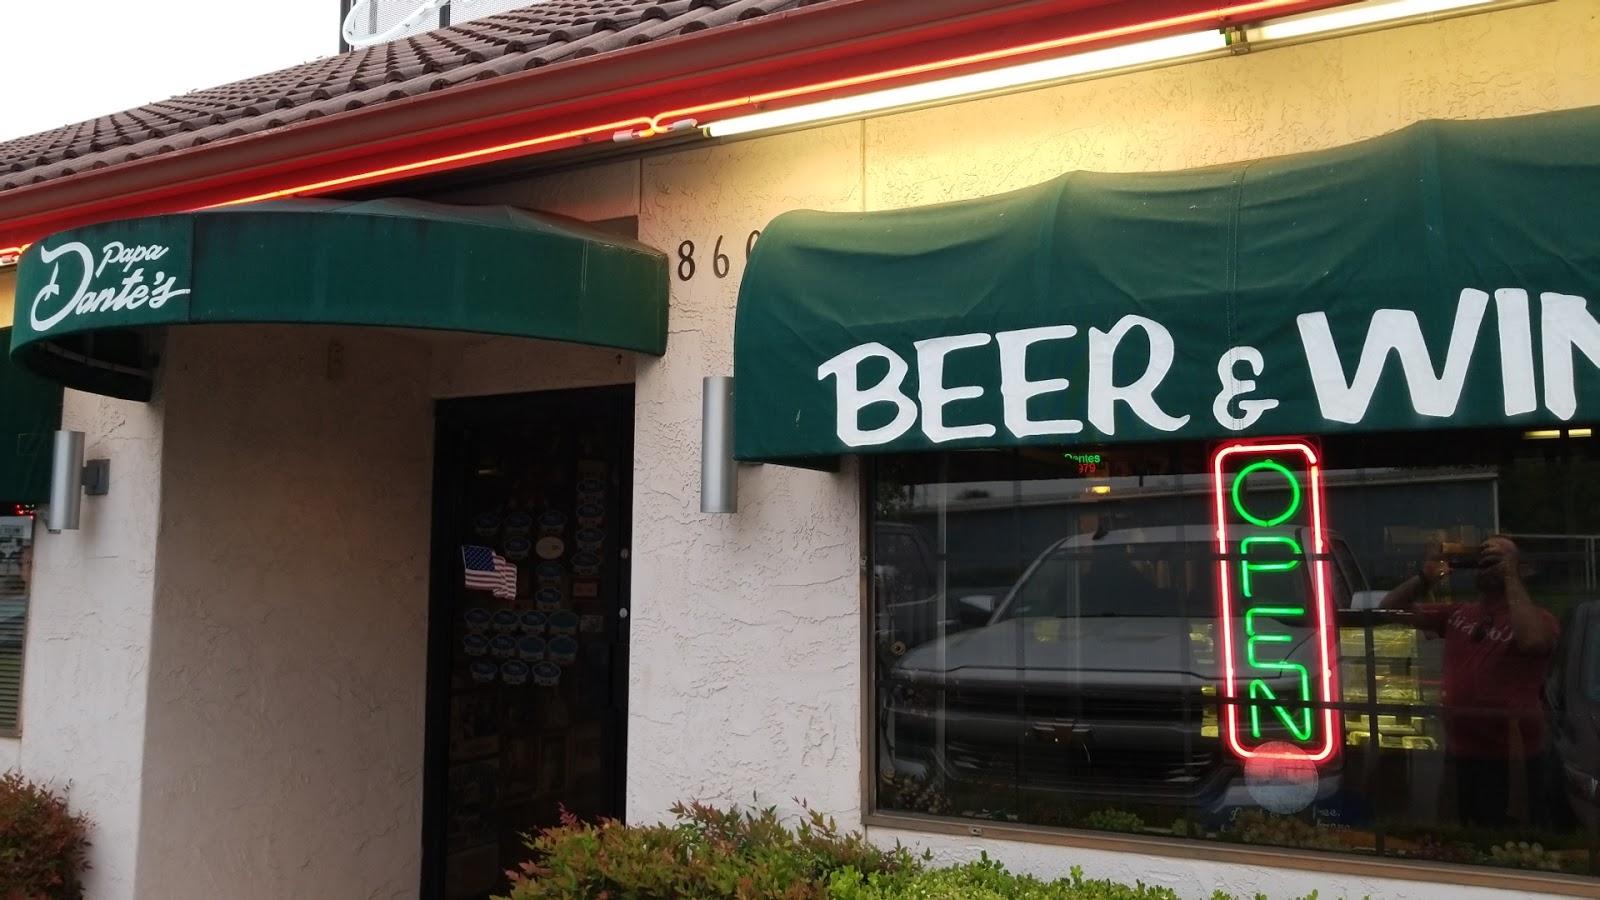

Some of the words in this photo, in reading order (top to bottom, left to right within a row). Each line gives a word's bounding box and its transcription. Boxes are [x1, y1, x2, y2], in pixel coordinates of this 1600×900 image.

[30, 241, 191, 332] Dante's
[95, 241, 169, 278] Papa
[817, 314, 1191, 447] BEER
[1212, 345, 1280, 431] &
[1231, 460, 1312, 740] OPEN
